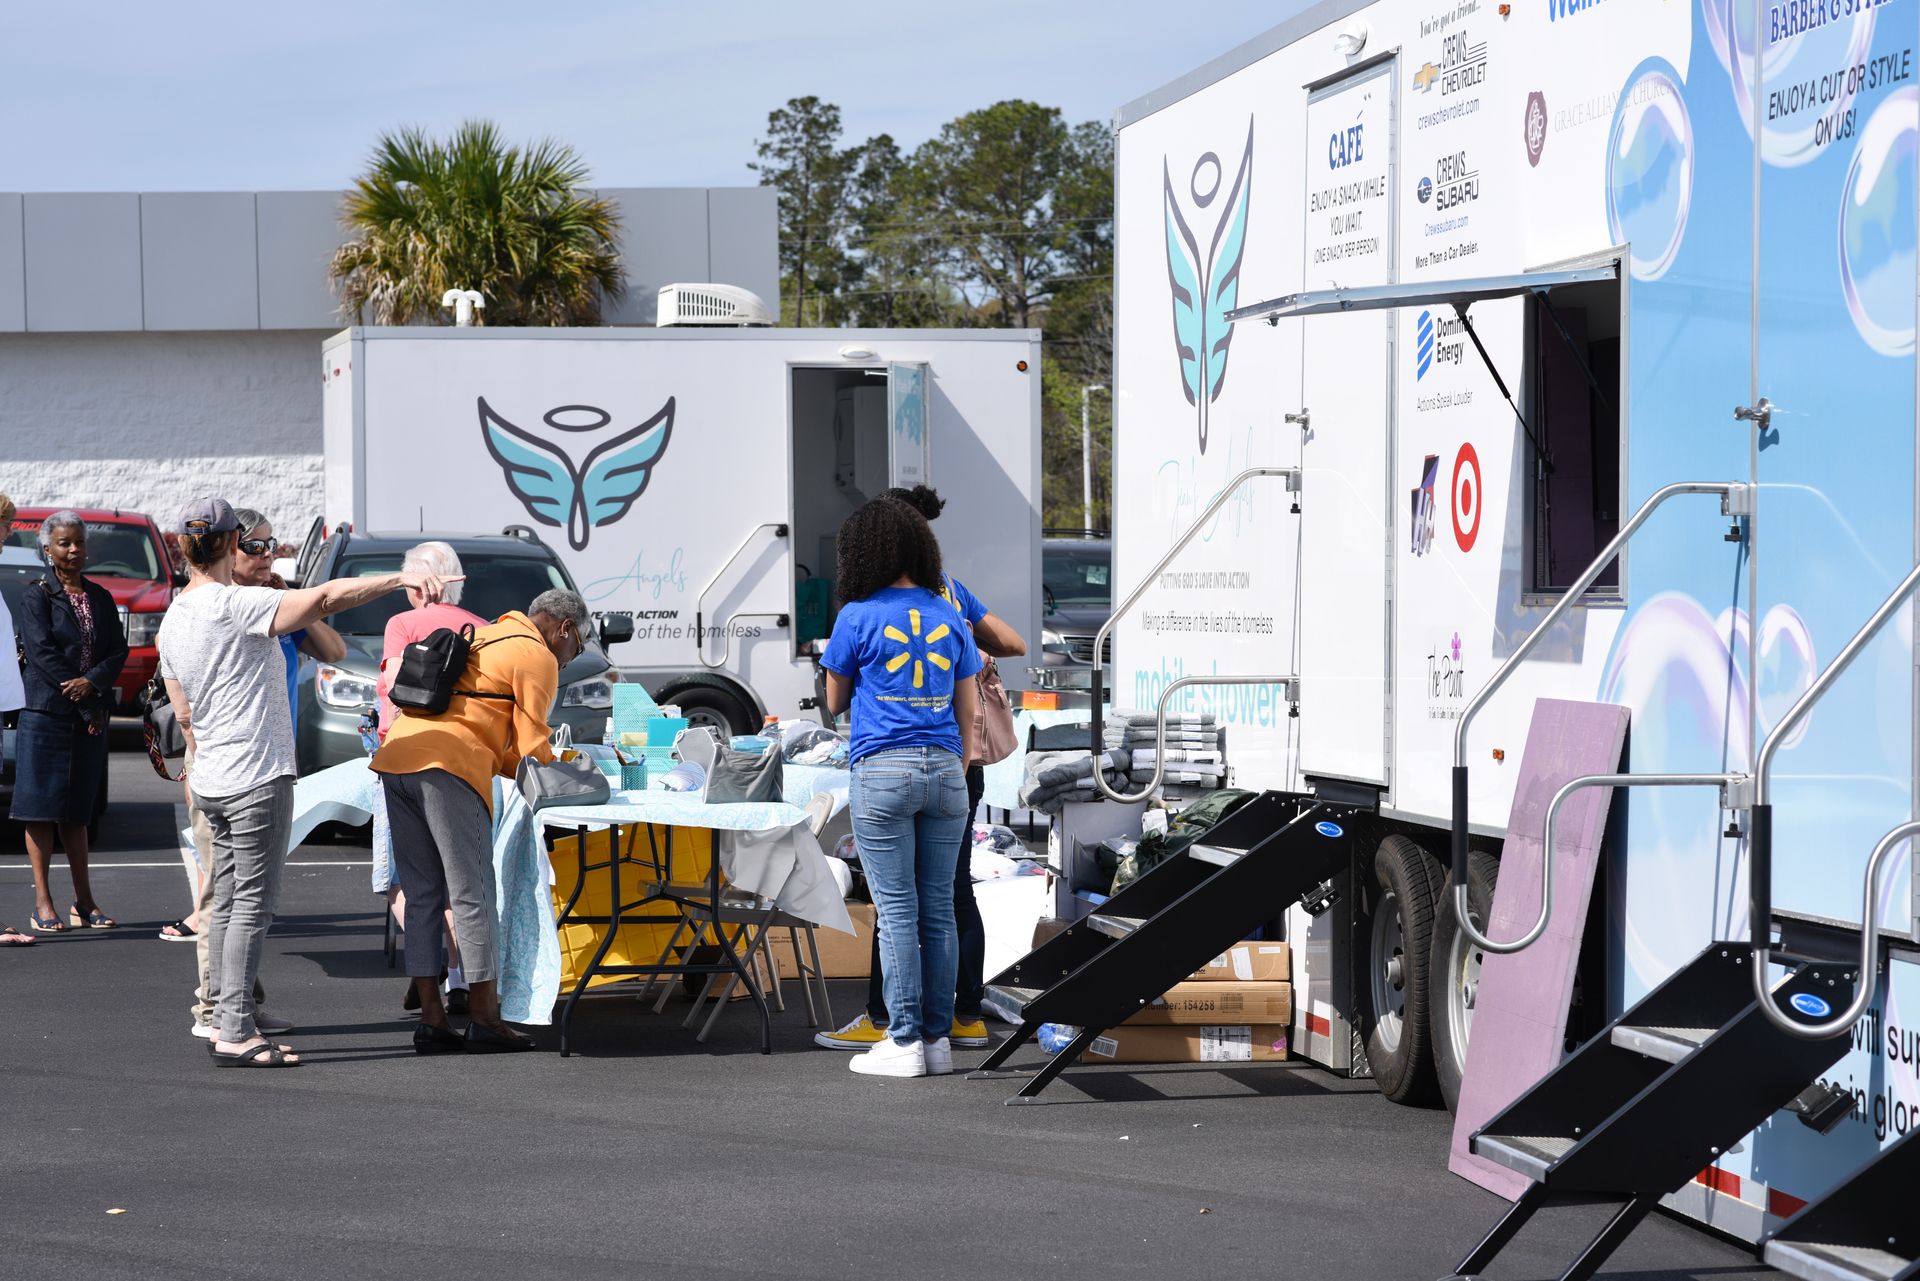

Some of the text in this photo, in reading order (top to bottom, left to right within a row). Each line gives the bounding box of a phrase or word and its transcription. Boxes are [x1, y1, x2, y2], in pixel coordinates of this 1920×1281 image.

[1440, 11, 1450, 33] got
[1770, 0, 1827, 43] BARBER
[1442, 30, 1467, 69] CREWS
[1441, 62, 1487, 96] CHEVROLET
[1769, 49, 1911, 120] ENJOY A CUT OR STYLE
[1418, 98, 1480, 130] crewschevrolet.com
[1815, 108, 1857, 146] ON US!
[1329, 110, 1364, 170] CAFÉ
[1437, 150, 1466, 185] CREWS
[1311, 188, 1333, 213] ENJOY
[1339, 181, 1363, 206] SNACK
[1363, 175, 1386, 200] WHILE
[1437, 179, 1479, 211] SUBARU
[1330, 210, 1363, 236] YOU WAIT.
[1327, 243, 1344, 262] SNACK
[1345, 241, 1356, 258] PER
[1415, 256, 1429, 269] More
[1429, 251, 1443, 265] Than
[1448, 246, 1459, 260] Car
[1459, 241, 1479, 257] Dealer.
[1437, 342, 1464, 365] Energy
[1436, 390, 1453, 411] Speak
[1454, 387, 1473, 406] Louder
[582, 547, 687, 602] Angels
[1182, 572, 1198, 589] GOD'S
[1199, 572, 1213, 589] LOVE
[1213, 572, 1227, 589] INTO
[1228, 571, 1250, 589] ACTION
[636, 610, 679, 620] ACTION
[637, 622, 761, 639] of the homeless
[1142, 610, 1161, 636] Making
[1165, 610, 1192, 632] difference
[1192, 611, 1198, 632] in
[1199, 611, 1209, 633] the
[1210, 611, 1223, 633] lives
[1224, 610, 1232, 633] of
[1232, 611, 1242, 634] the
[1242, 611, 1274, 635] homeless
[1135, 656, 1281, 728] mobile shower
[1183, 999, 1215, 1011] 154258
[1850, 1007, 1880, 1057] will
